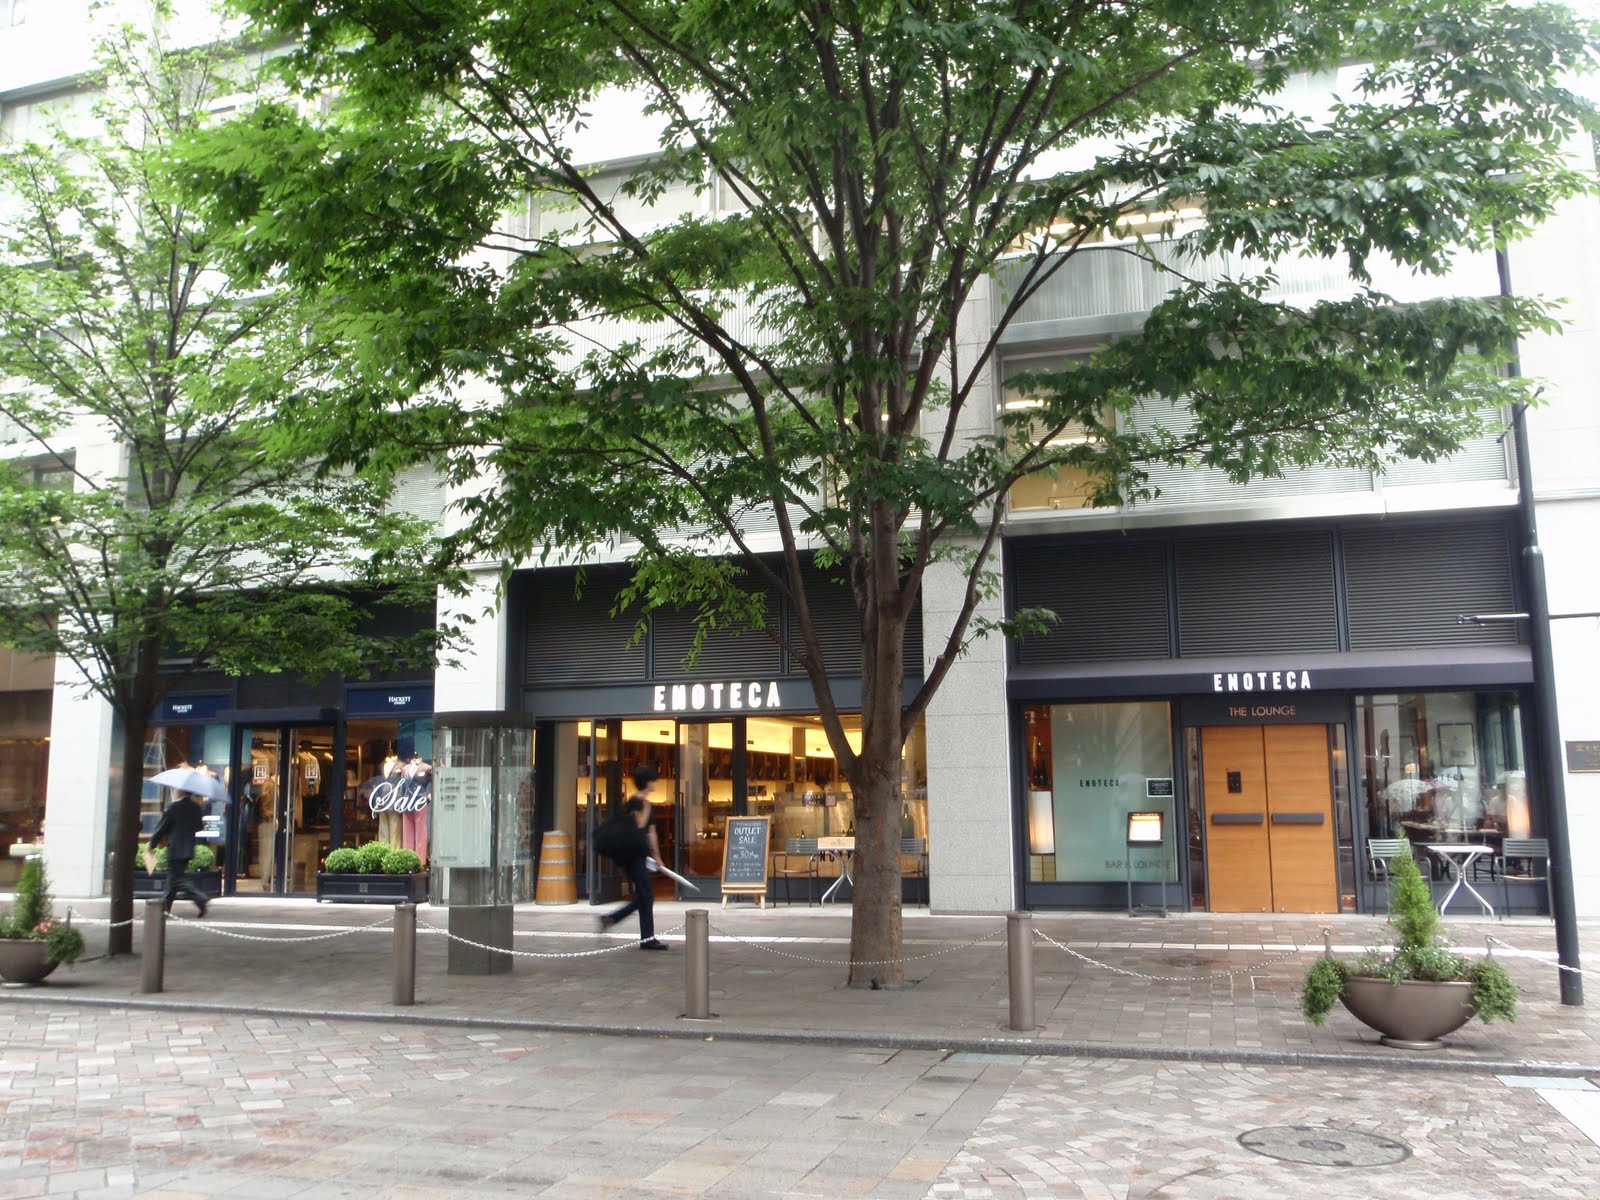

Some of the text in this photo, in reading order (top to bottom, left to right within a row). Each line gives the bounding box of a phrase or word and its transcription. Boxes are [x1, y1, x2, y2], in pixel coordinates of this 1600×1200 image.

[1213, 671, 1311, 691] ENOTECA
[654, 682, 780, 711] ENOTECA
[1229, 705, 1296, 717] THE LOUNGE
[1079, 779, 1120, 787] ENOTECA
[369, 778, 427, 819] Sale
[734, 827, 761, 835] OUTLET
[738, 836, 757, 844] SALE
[1104, 860, 1122, 869] BAR
